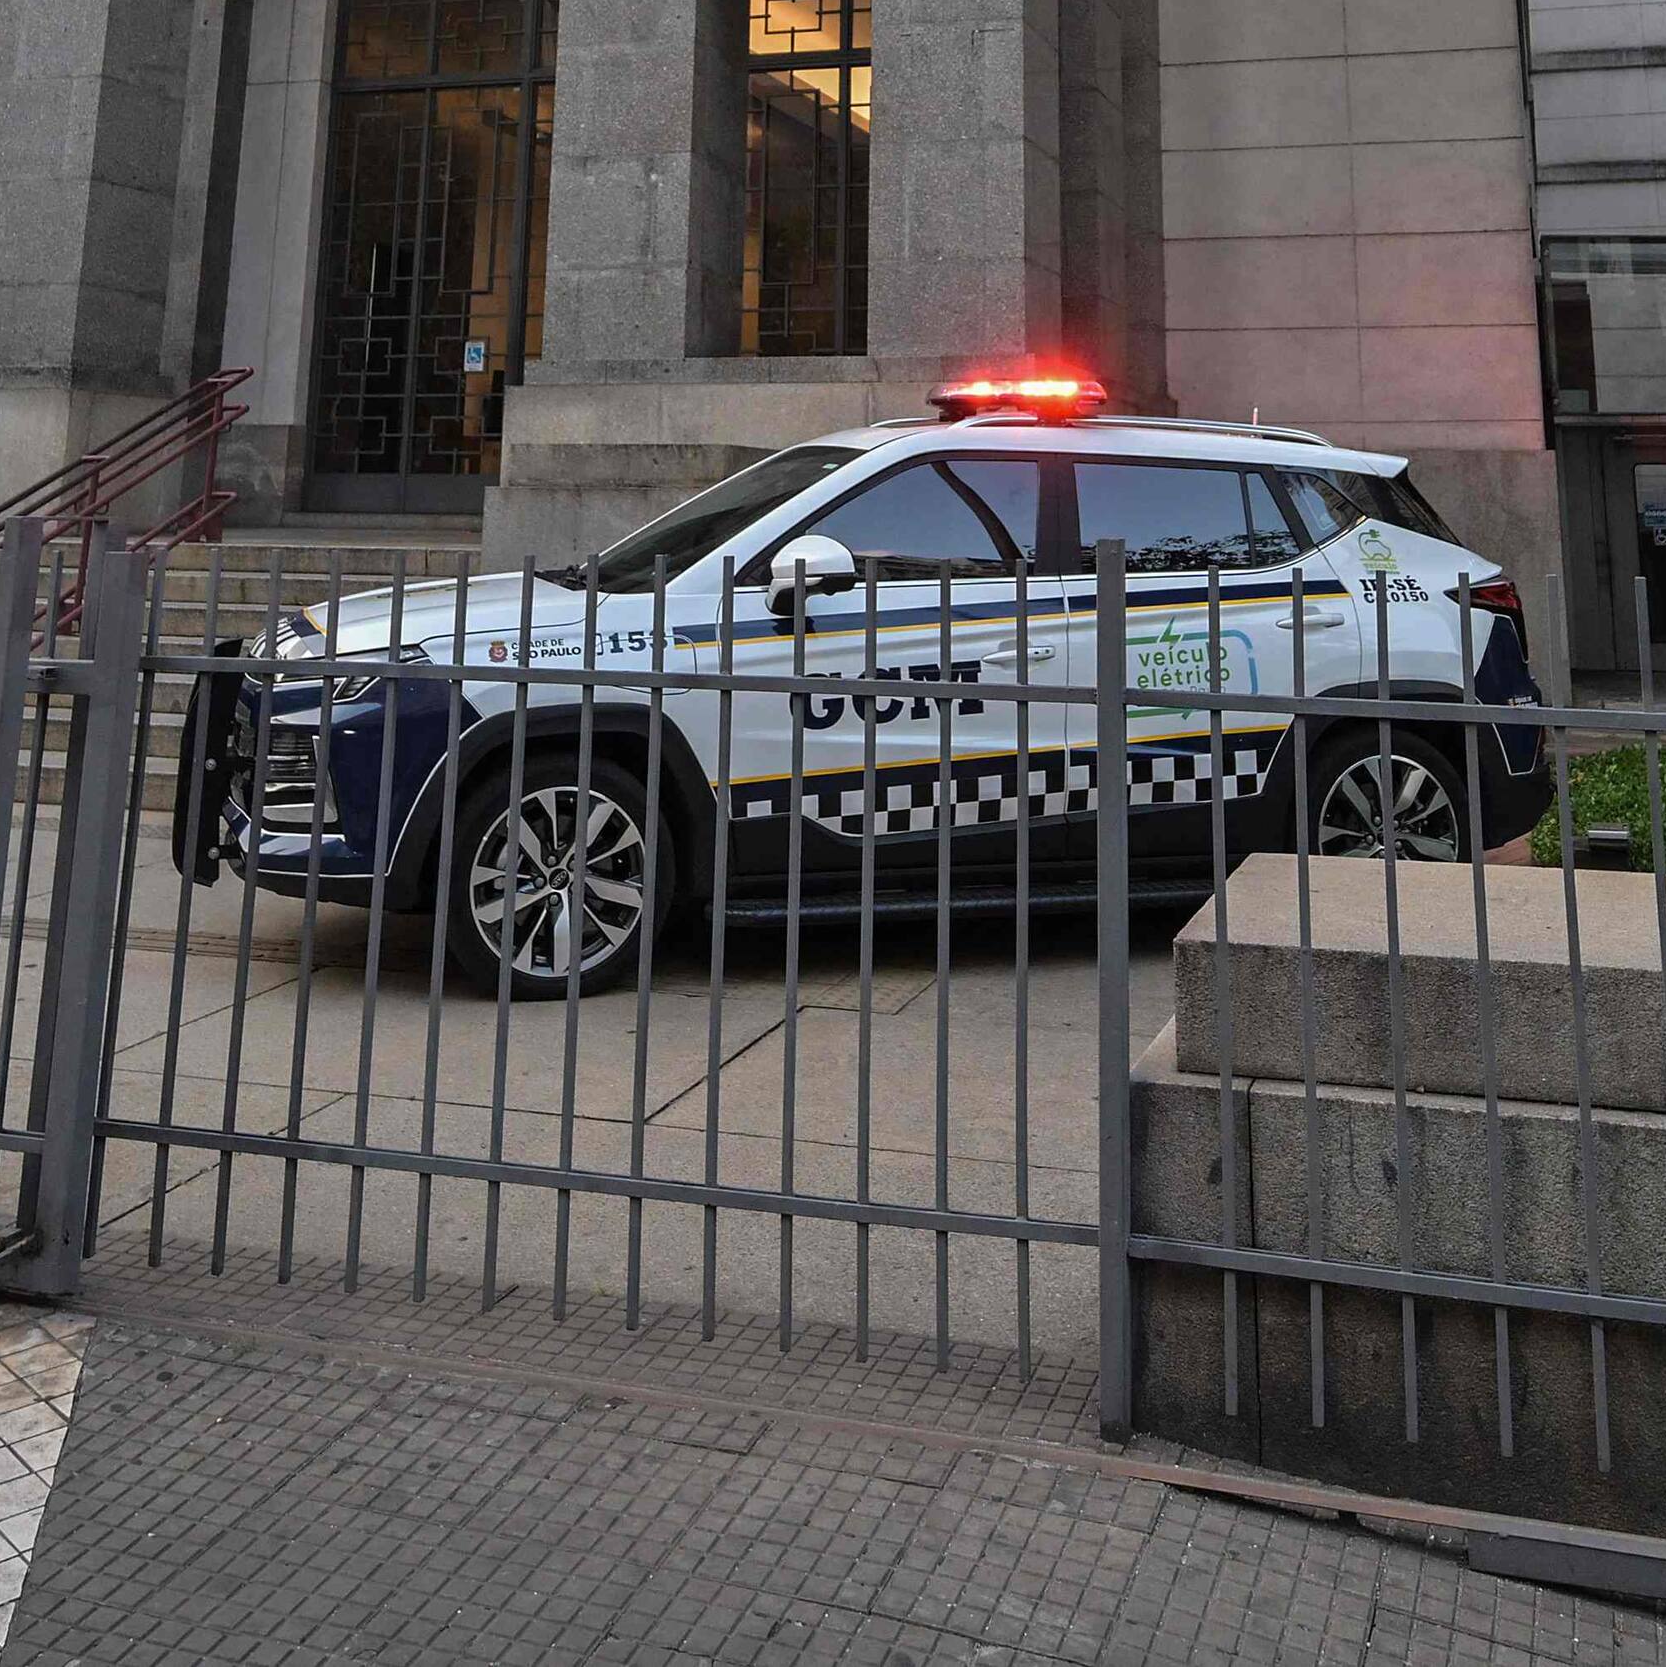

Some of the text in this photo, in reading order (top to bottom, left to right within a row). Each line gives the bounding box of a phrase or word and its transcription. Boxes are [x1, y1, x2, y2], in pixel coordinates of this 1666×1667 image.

[551, 638, 564, 646] DE
[512, 646, 582, 661] SO PAULO
